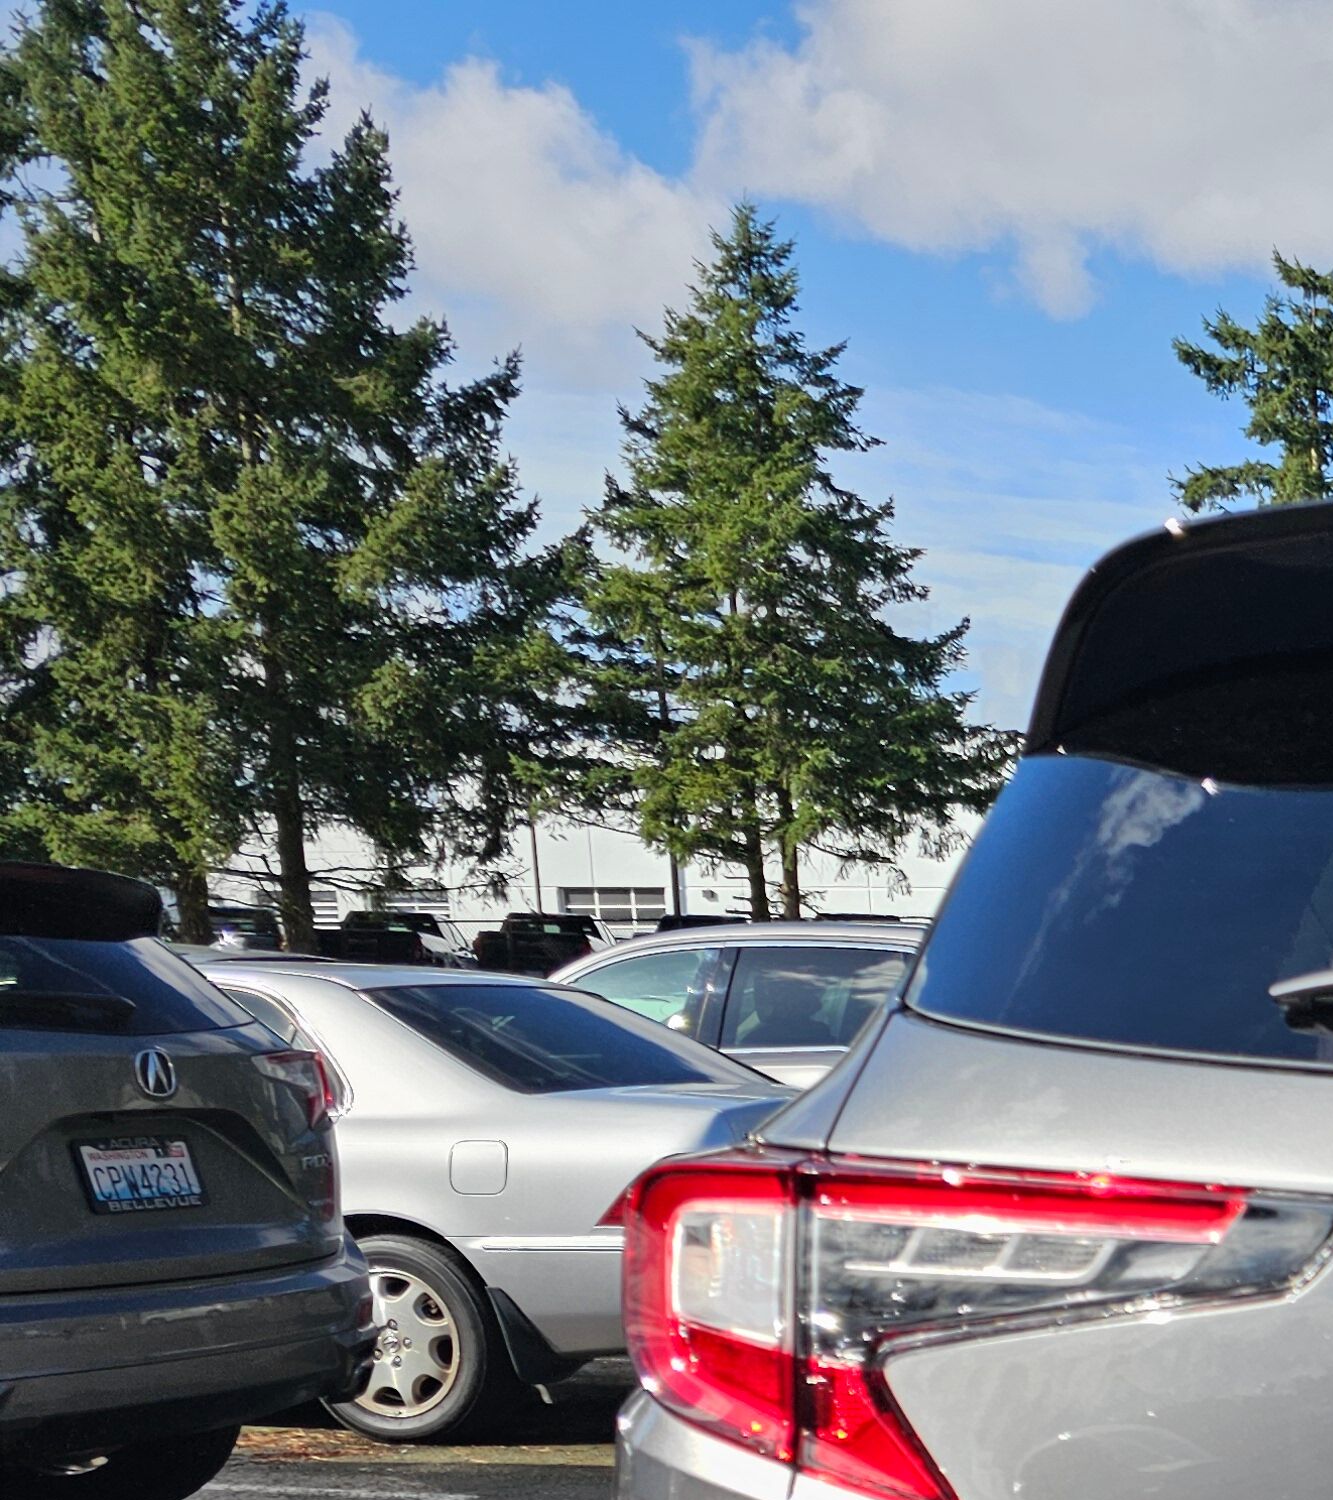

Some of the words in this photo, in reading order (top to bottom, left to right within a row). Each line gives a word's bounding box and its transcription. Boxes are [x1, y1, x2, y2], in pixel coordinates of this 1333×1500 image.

[110, 1137, 160, 1149] ACURA
[93, 1163, 197, 1200] CPN4231
[108, 1195, 202, 1212] BELLEVUE
